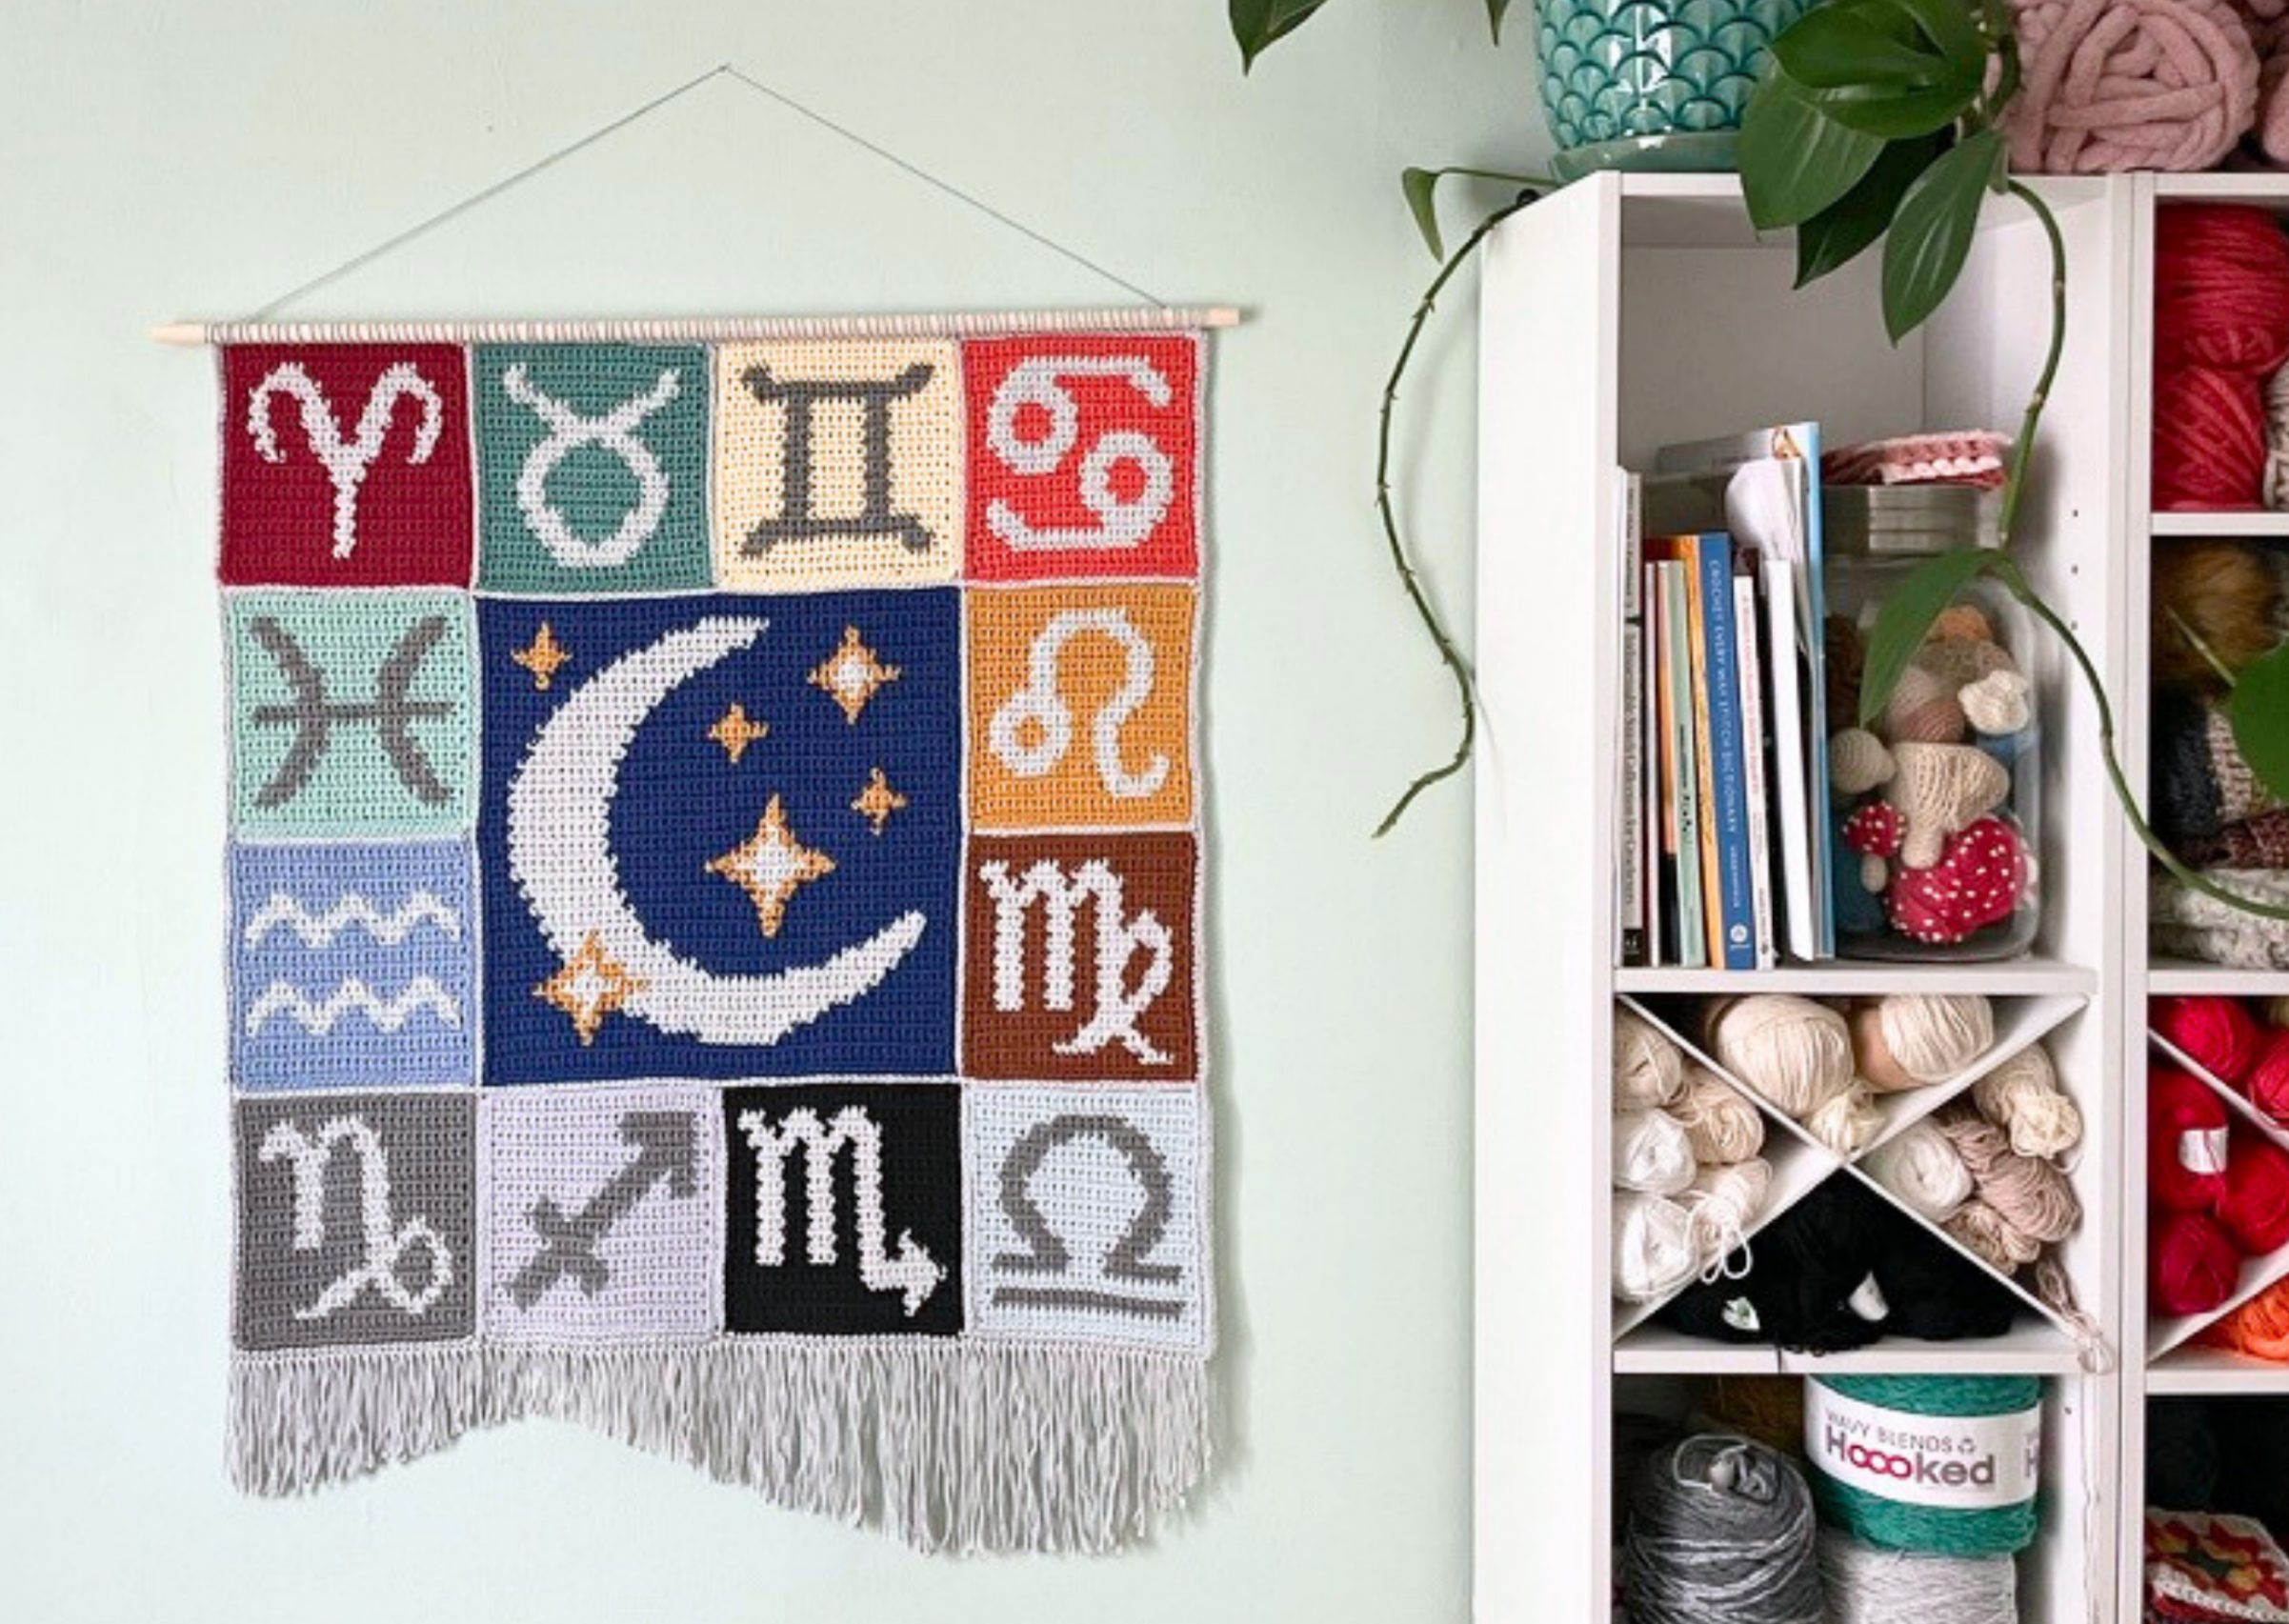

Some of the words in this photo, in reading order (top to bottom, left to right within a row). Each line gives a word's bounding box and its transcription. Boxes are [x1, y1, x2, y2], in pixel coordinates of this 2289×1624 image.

[1709, 559, 1723, 624] CROCHET
[1715, 626, 1725, 664] EVERY
[1717, 668, 1727, 696] WAY
[1717, 701, 1732, 747] STITCH
[1721, 752, 1737, 832] DICTIONARY
[1826, 1425, 1995, 1486] Hoooked
[1877, 1427, 1952, 1454] BLENDS
